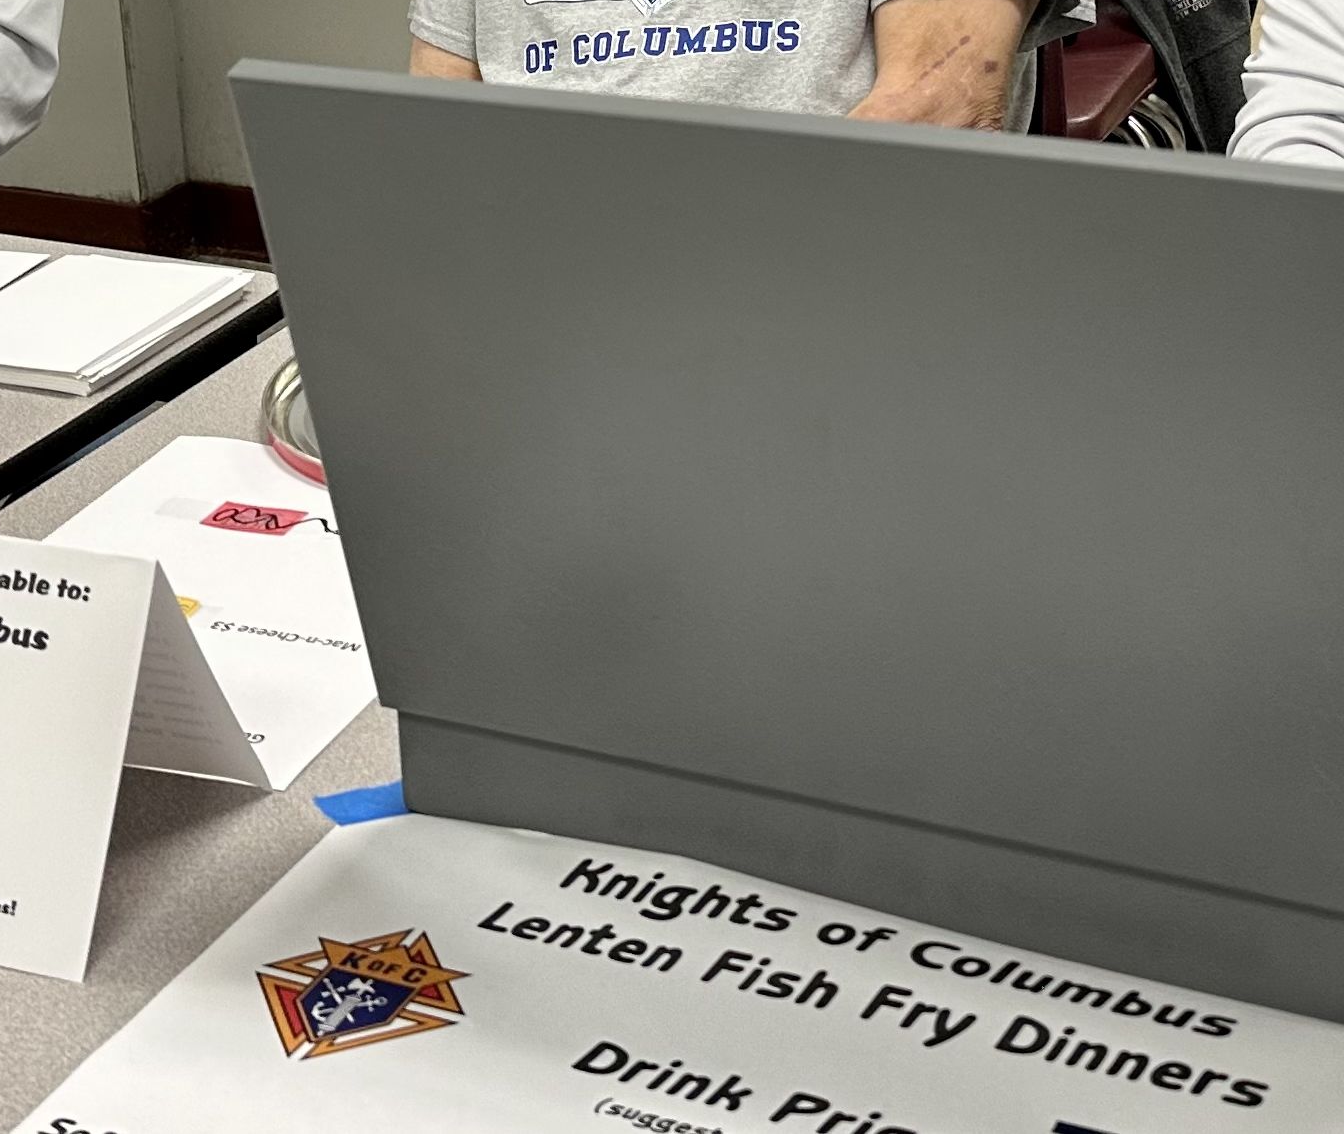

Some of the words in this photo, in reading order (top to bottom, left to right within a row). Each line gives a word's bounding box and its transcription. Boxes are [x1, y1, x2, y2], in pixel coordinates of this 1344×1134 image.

[525, 39, 558, 74] OF
[573, 20, 800, 67] COLUMBUS
[56, 580, 92, 603] to:
[343, 950, 361, 968] K
[403, 965, 428, 984] C
[560, 858, 798, 933] Knights
[816, 920, 898, 954] of
[910, 939, 1241, 1041] Columbus
[477, 901, 683, 975] Lenten
[701, 950, 841, 1010] Fish
[859, 984, 978, 1048] Fry
[994, 1015, 1272, 1109] Dinners
[570, 1040, 754, 1111] Drink
